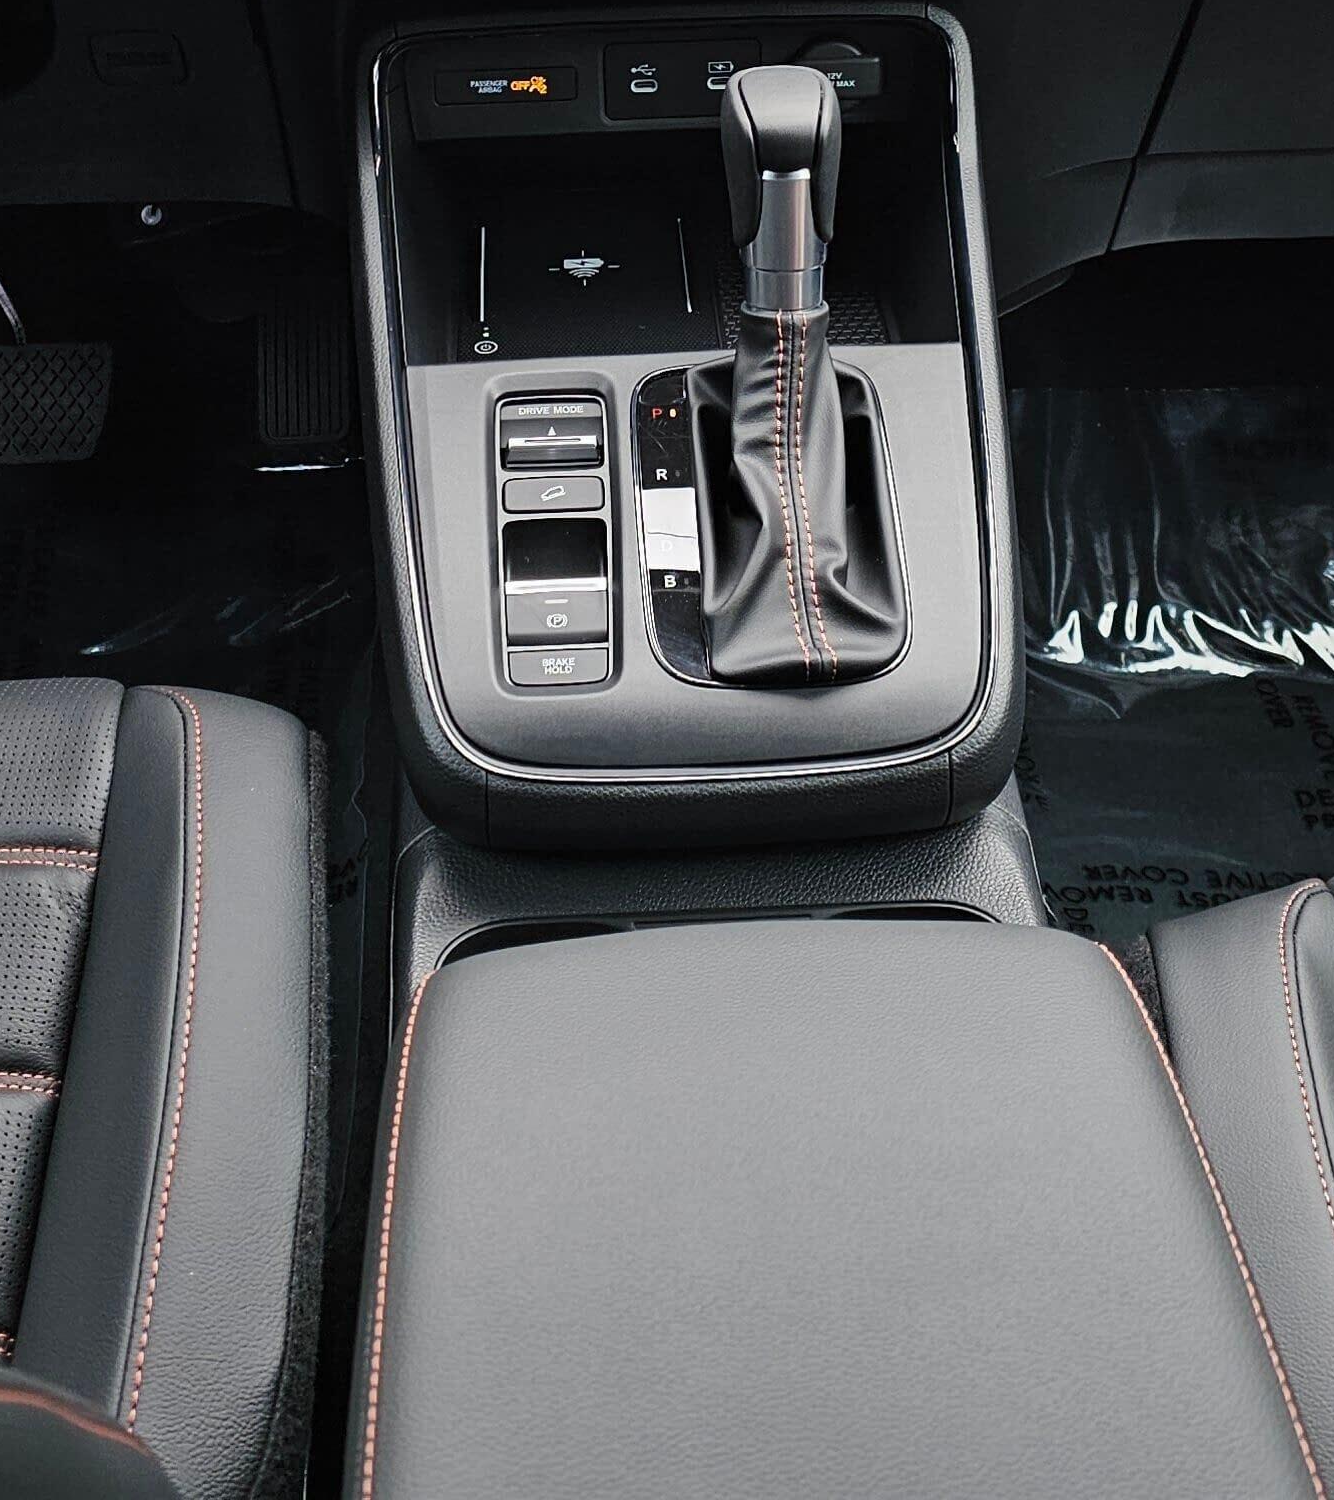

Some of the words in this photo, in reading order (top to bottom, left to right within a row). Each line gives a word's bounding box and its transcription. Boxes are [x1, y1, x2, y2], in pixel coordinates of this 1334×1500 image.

[470, 80, 508, 88] PASSENGER
[510, 80, 530, 91] OFF
[518, 406, 549, 416] DRIVE
[553, 405, 584, 415] MODE
[652, 408, 663, 420] P
[656, 469, 668, 481] R
[664, 575, 677, 588] B
[542, 657, 576, 667] BRAKE
[545, 665, 573, 675] HOLD
[1082, 864, 1189, 885] COVER
[1043, 883, 1154, 905] REMOV
